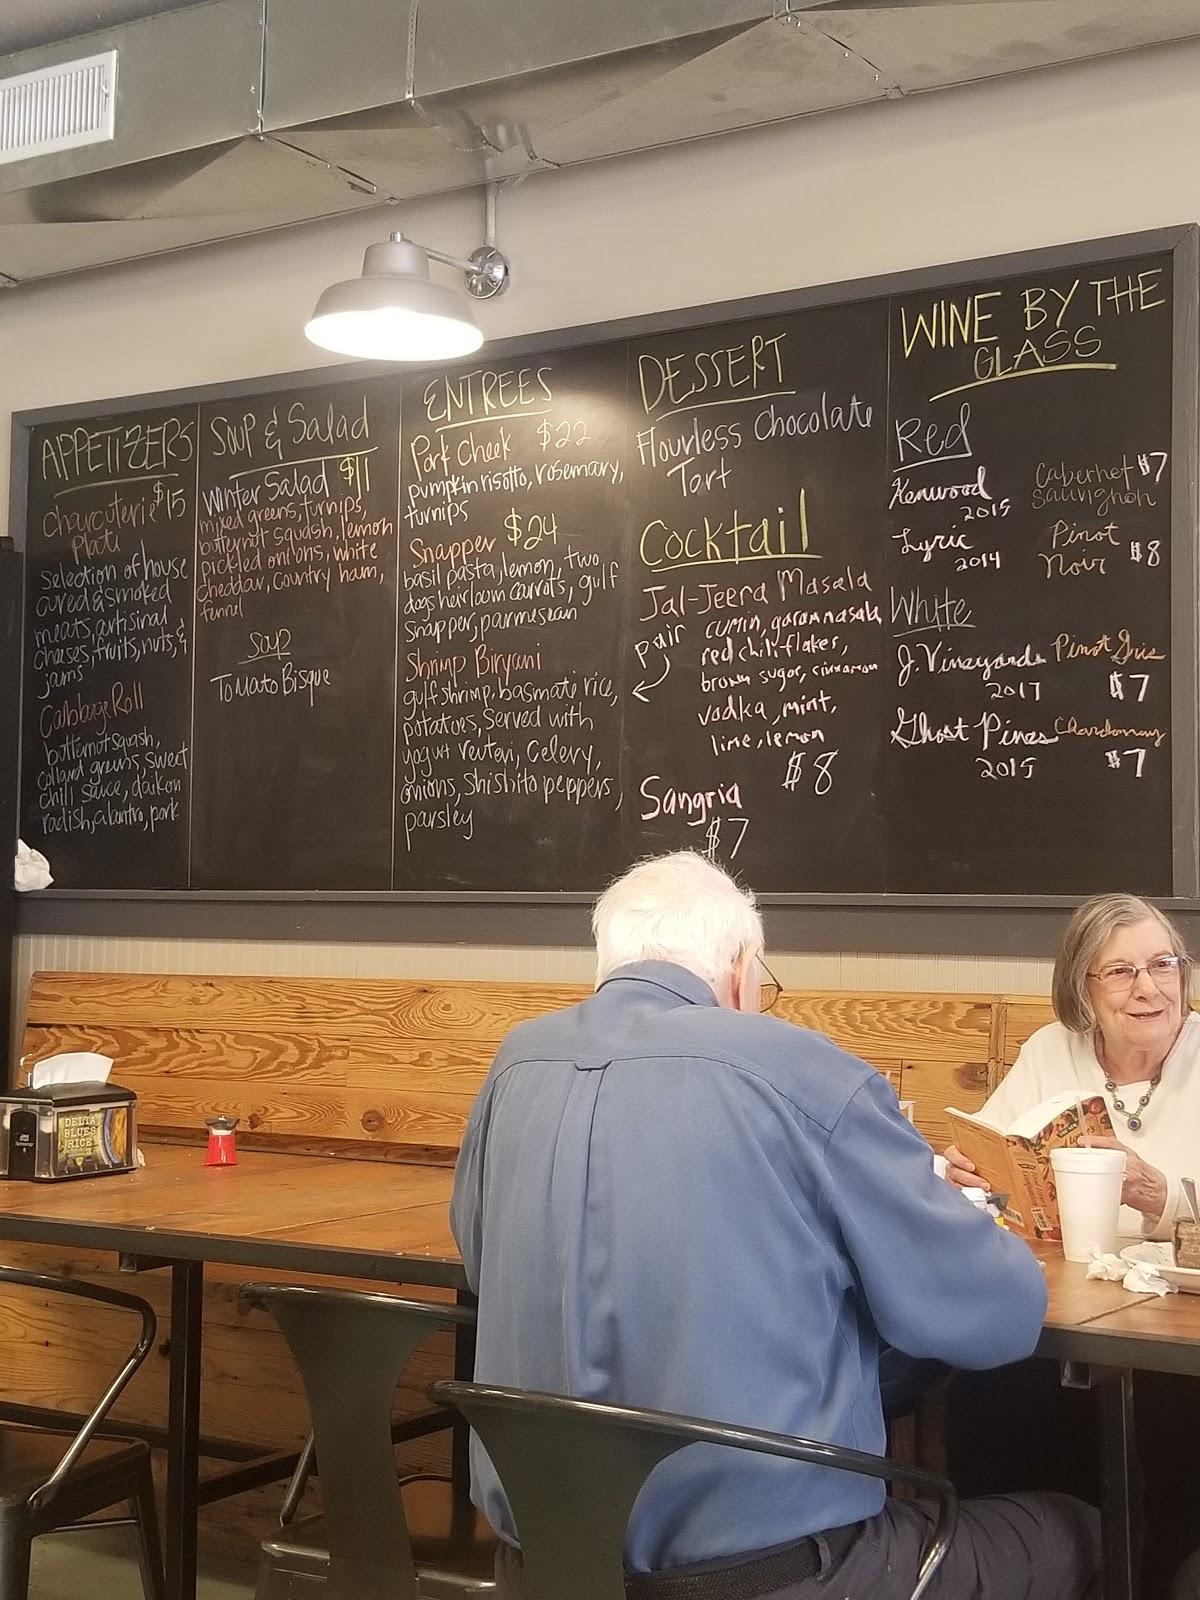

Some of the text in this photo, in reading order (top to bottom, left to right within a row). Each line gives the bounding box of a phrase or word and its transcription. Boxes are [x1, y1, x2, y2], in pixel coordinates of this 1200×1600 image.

[900, 268, 1166, 359] WINE BY THE
[973, 325, 1102, 380] GLASS
[638, 333, 787, 415] DESSERT
[423, 367, 553, 422] ENTREES
[264, 406, 283, 460] &
[287, 396, 369, 445] Salad
[636, 417, 742, 468] Flourless
[895, 402, 973, 463] Red
[41, 418, 195, 481] APPETIZERS
[410, 434, 451, 482] Pork
[536, 417, 592, 451] $22
[264, 459, 330, 501] Salad
[339, 456, 370, 500] $11
[408, 474, 479, 508] pumpkin
[889, 465, 993, 510] Kenwood
[1035, 454, 1135, 489] Cabernet
[43, 480, 186, 538] Charcuterie $15
[247, 500, 303, 537] greens,
[404, 499, 469, 529] turnips
[639, 487, 809, 567] Cocktail
[409, 507, 558, 570] Snapper $24
[892, 525, 976, 563] Lyric
[1050, 519, 1121, 550] Pinot
[1130, 540, 1161, 567] $8
[123, 552, 140, 580] of
[140, 539, 189, 581] house
[201, 551, 262, 584] pickled
[333, 537, 378, 561] white
[403, 563, 441, 592] basil
[563, 544, 600, 570] two
[954, 551, 1002, 572] 2014
[104, 578, 173, 608] smoked
[437, 580, 506, 612] heirloom
[578, 561, 619, 607] gulf
[777, 566, 873, 601] Masala
[176, 617, 187, 655] &
[701, 636, 734, 668] red
[1050, 633, 1112, 663] Pinot
[37, 664, 84, 700] jams
[281, 661, 331, 707] Bisque
[405, 643, 542, 688] Shrimp Biryani
[111, 681, 144, 717] Roll
[403, 679, 438, 721] gulf
[583, 671, 618, 707] rice,
[985, 682, 1042, 701] 2017
[1109, 671, 1150, 702] $7
[548, 702, 594, 731] with
[890, 707, 1060, 751] Ghost Pines
[402, 745, 450, 784] yogurt
[1104, 749, 1146, 778] $7
[131, 771, 181, 800] daikon
[639, 775, 744, 827] Sangria
[404, 803, 474, 852] parsley
[64, 1116, 97, 1128] DELTA
[64, 1127, 97, 1138] BLUES
[67, 1138, 93, 1149] RICE
